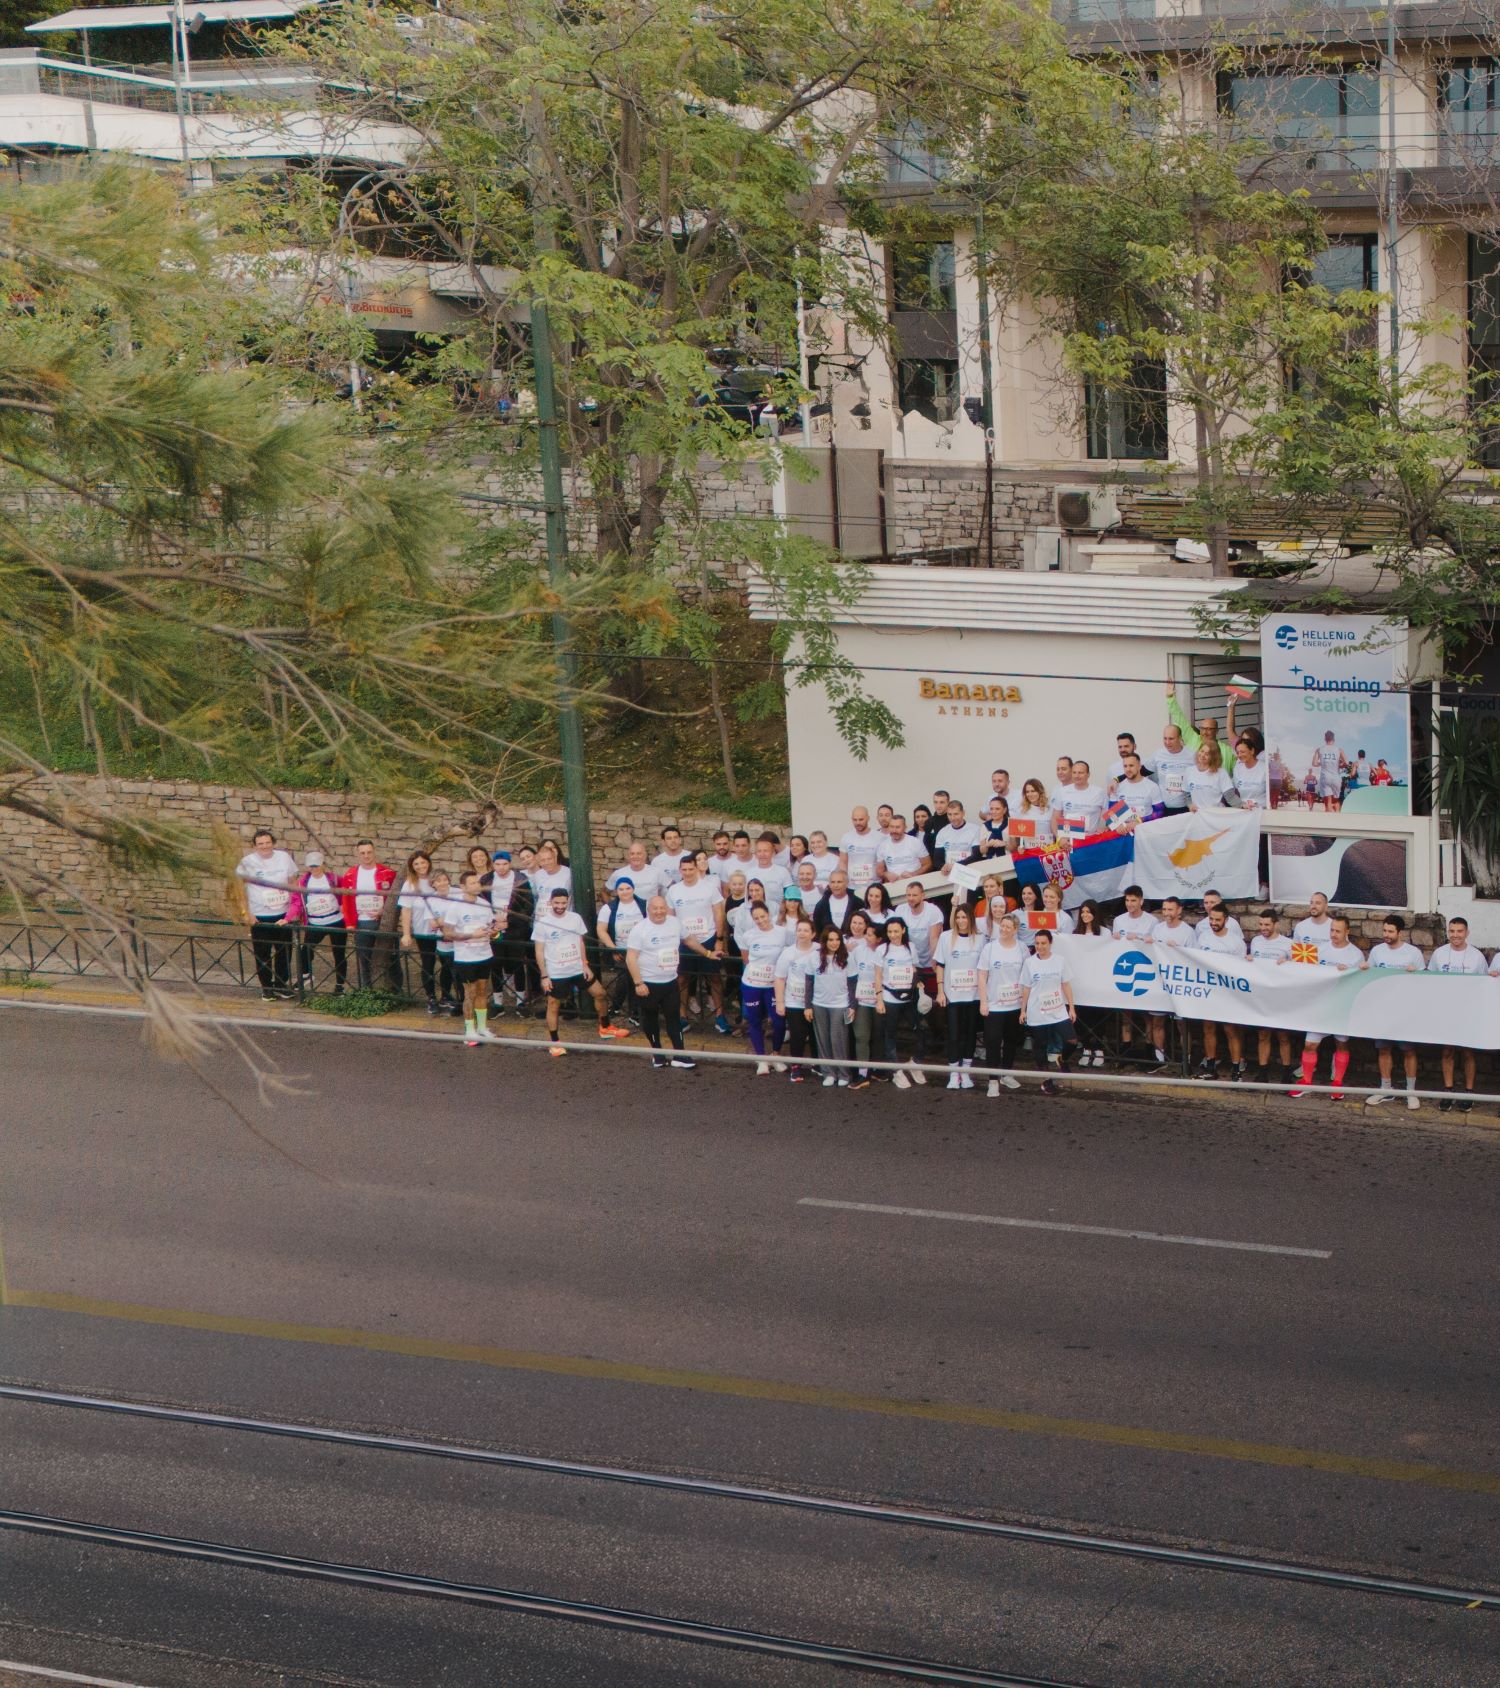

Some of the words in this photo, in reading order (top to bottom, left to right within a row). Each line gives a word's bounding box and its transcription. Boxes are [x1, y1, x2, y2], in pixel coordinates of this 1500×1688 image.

[1302, 630, 1356, 641] HELLENiQ
[918, 677, 1022, 703] Banana
[1303, 675, 1380, 698] Running
[938, 705, 1009, 718] ATHENS
[1303, 695, 1370, 713] Station
[1158, 963, 1252, 993] HELLENiQ
